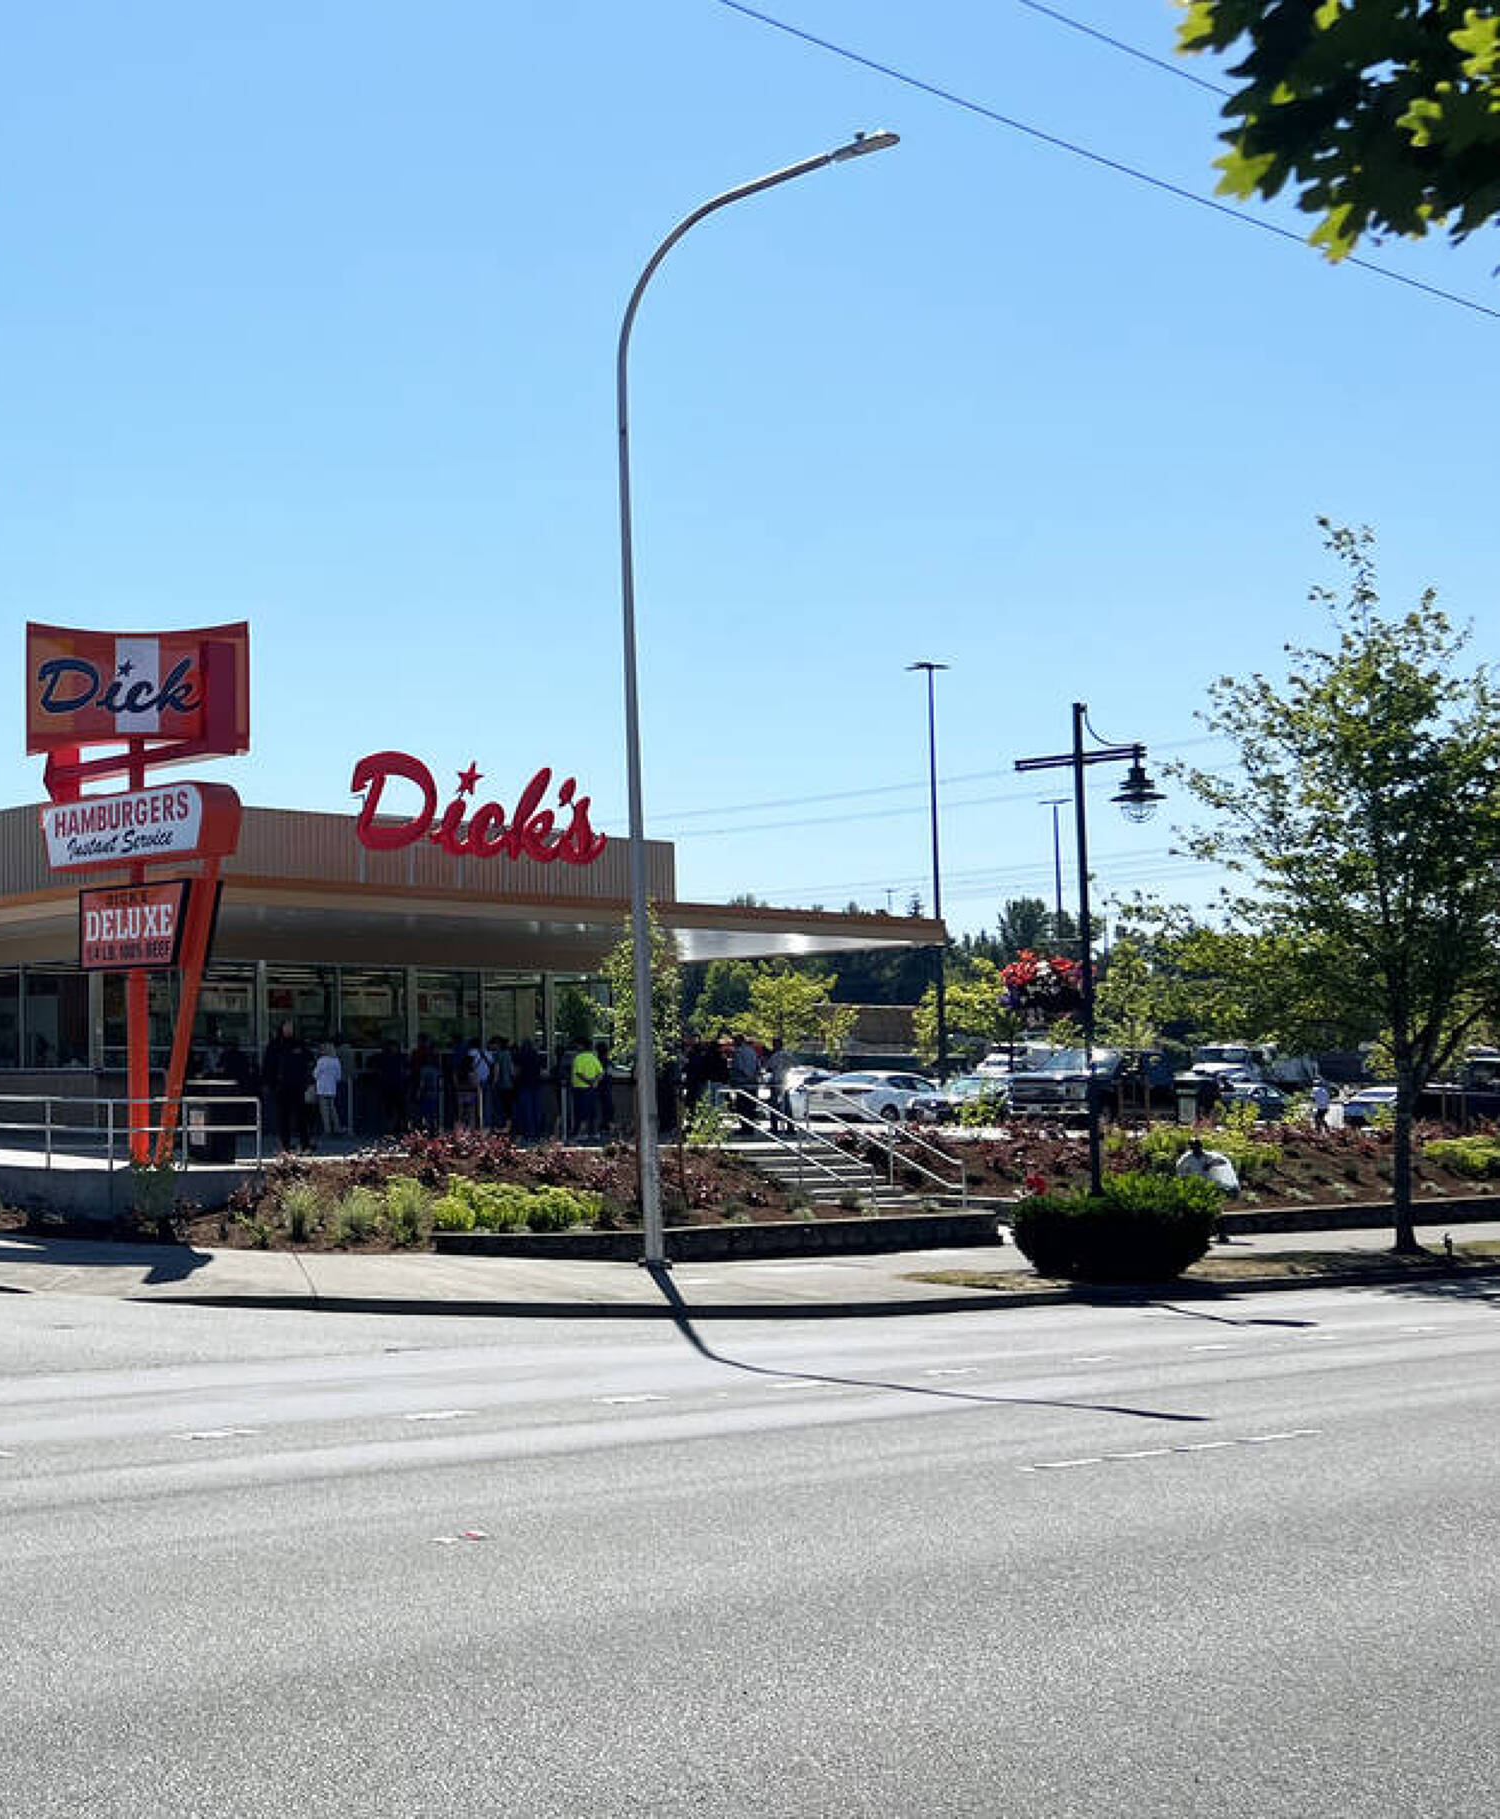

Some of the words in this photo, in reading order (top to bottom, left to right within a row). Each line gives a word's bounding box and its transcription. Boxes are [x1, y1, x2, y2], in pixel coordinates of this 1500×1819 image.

[38, 657, 200, 713] Dick
[54, 790, 188, 838] HAMBURGERS
[351, 751, 607, 865] Dick's
[66, 834, 119, 861] Instant
[121, 827, 173, 853] Service
[84, 904, 173, 942] DELUXE
